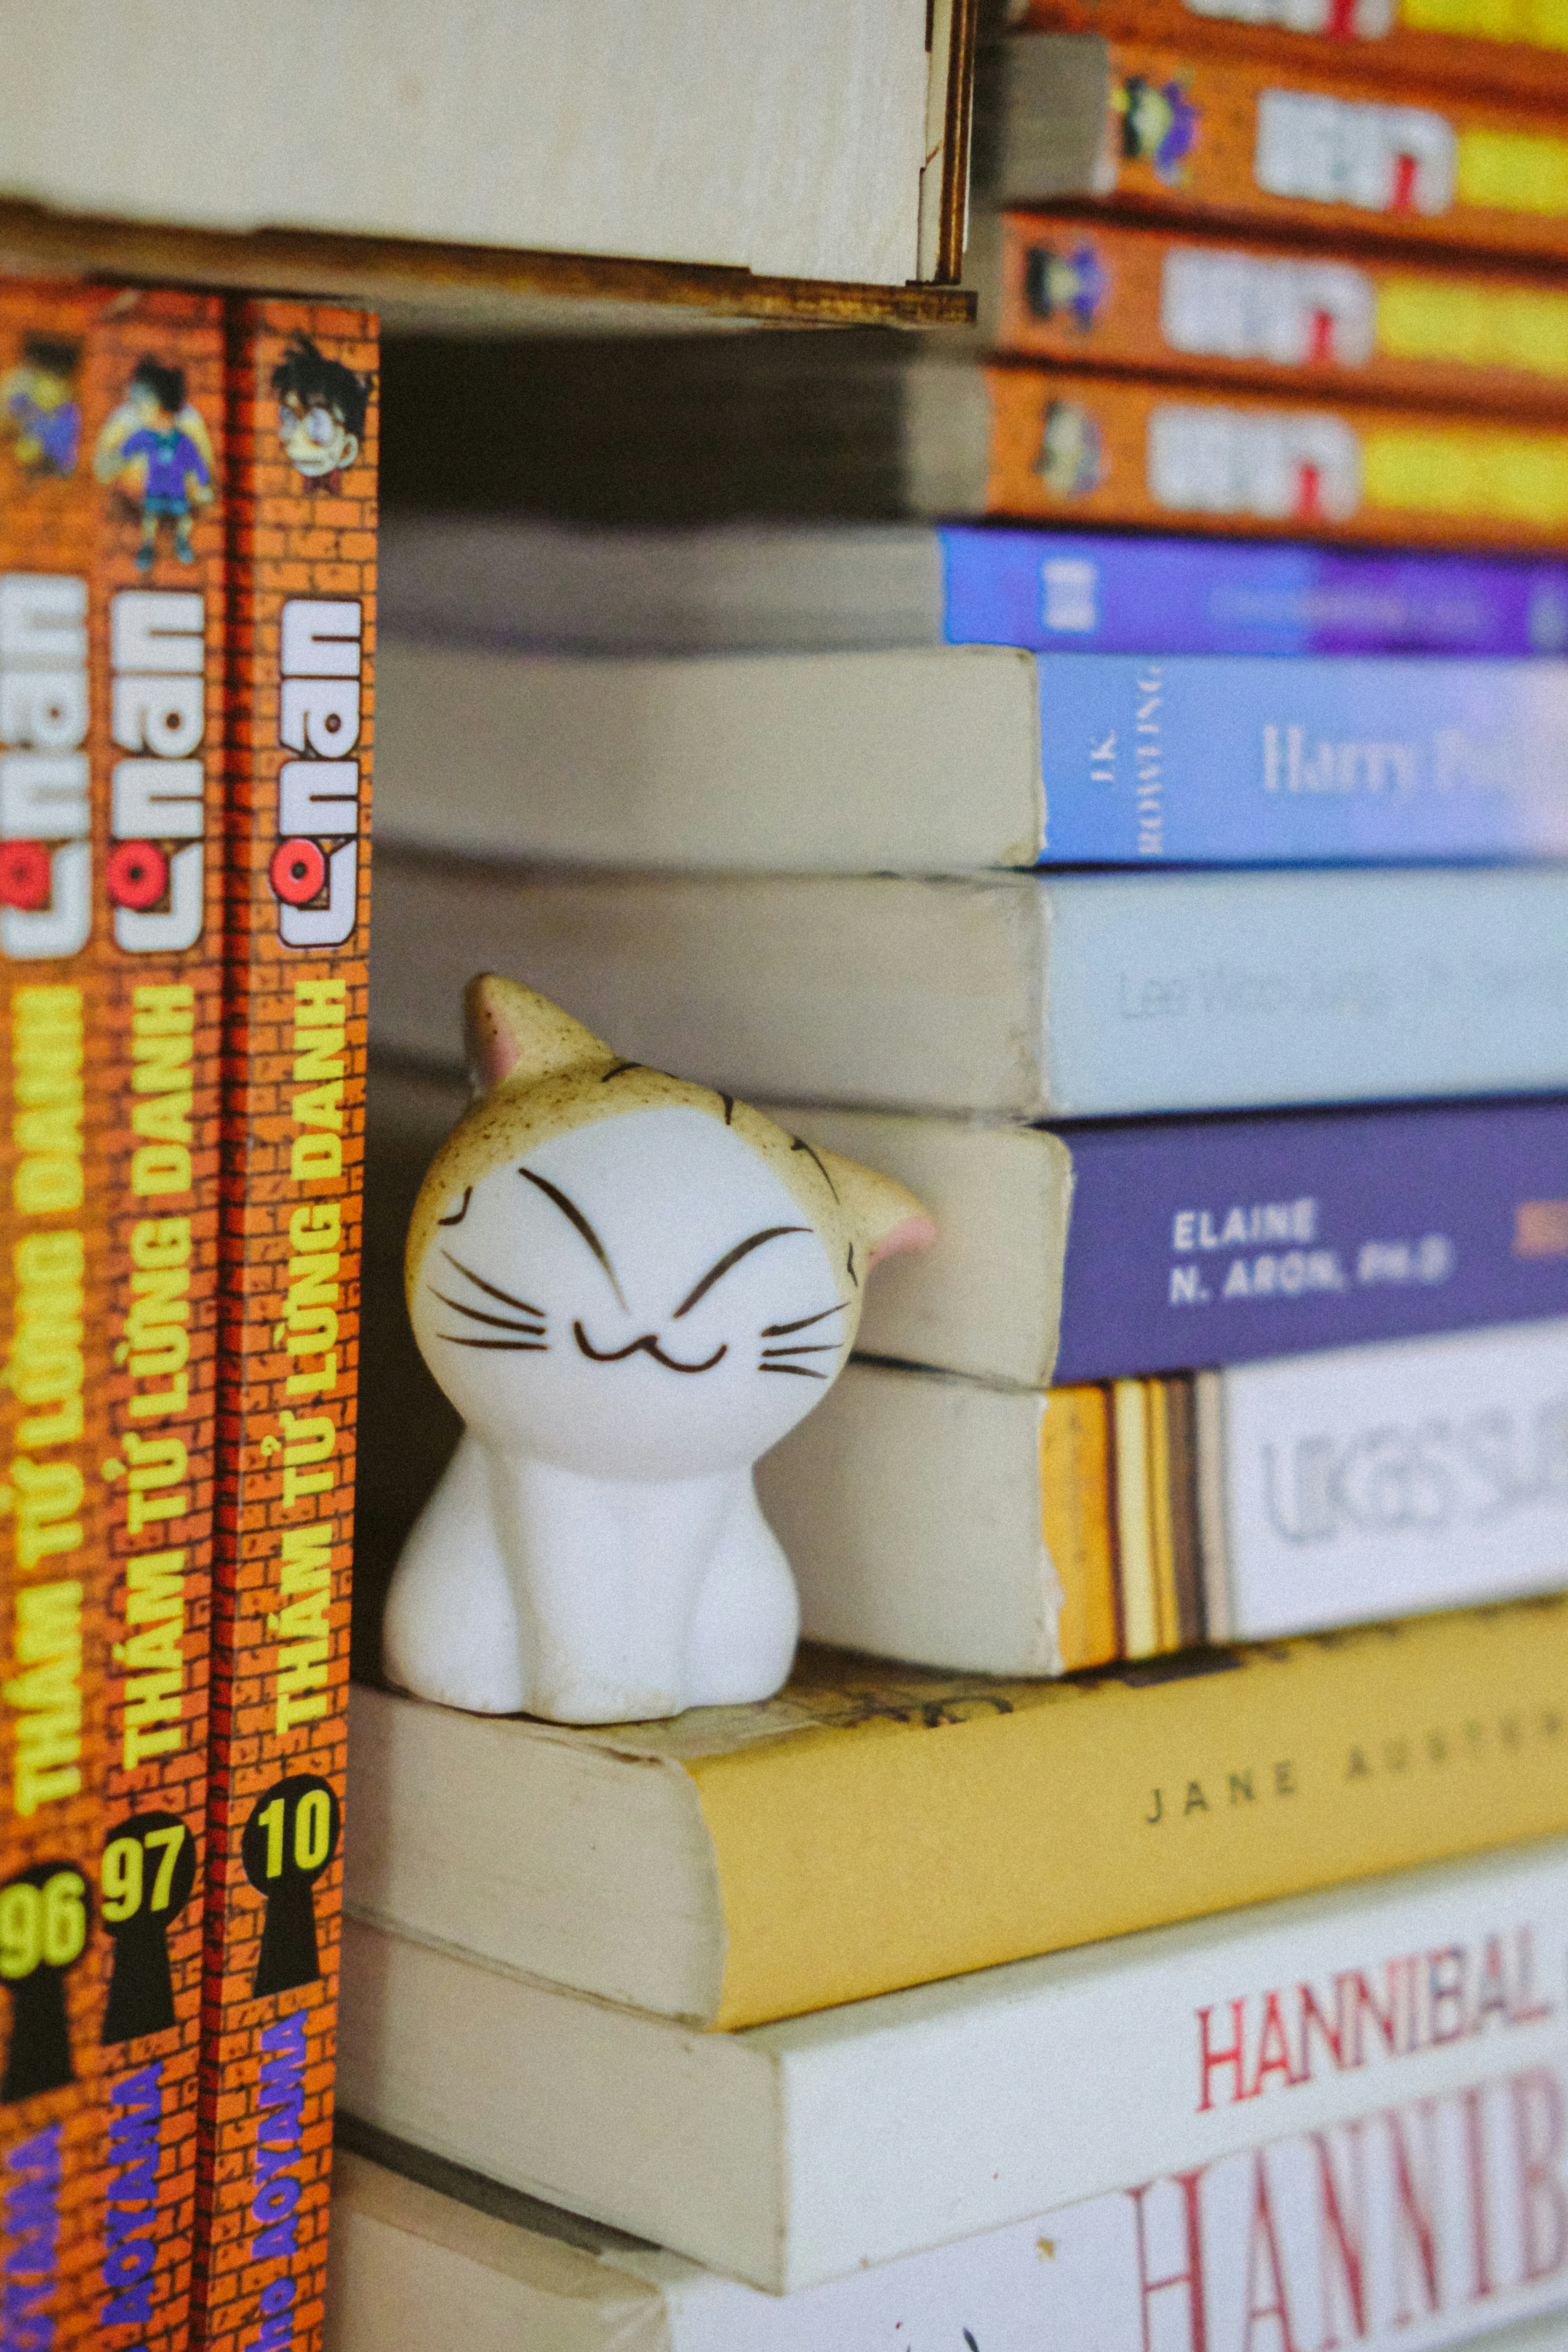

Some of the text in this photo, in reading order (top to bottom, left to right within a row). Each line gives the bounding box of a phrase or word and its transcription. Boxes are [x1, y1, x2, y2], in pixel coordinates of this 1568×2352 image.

[14, 986, 83, 1213] DANH
[1169, 1265, 1210, 1305] N.
[1173, 1196, 1316, 1250] ELAINE
[103, 985, 193, 1769] THÁM TỬ LỪNG DANH
[261, 979, 345, 1735] THÁM TỬ LỪNG DANH
[259, 1789, 330, 1878] 10
[1145, 1758, 1297, 1825] JANE
[0, 1871, 86, 1979] 96
[102, 1825, 185, 1921] 97
[1195, 1923, 1554, 2114] HANNIBAL
[101, 2061, 163, 2325] AOYAMA
[252, 2009, 308, 2259] AOYAMA
